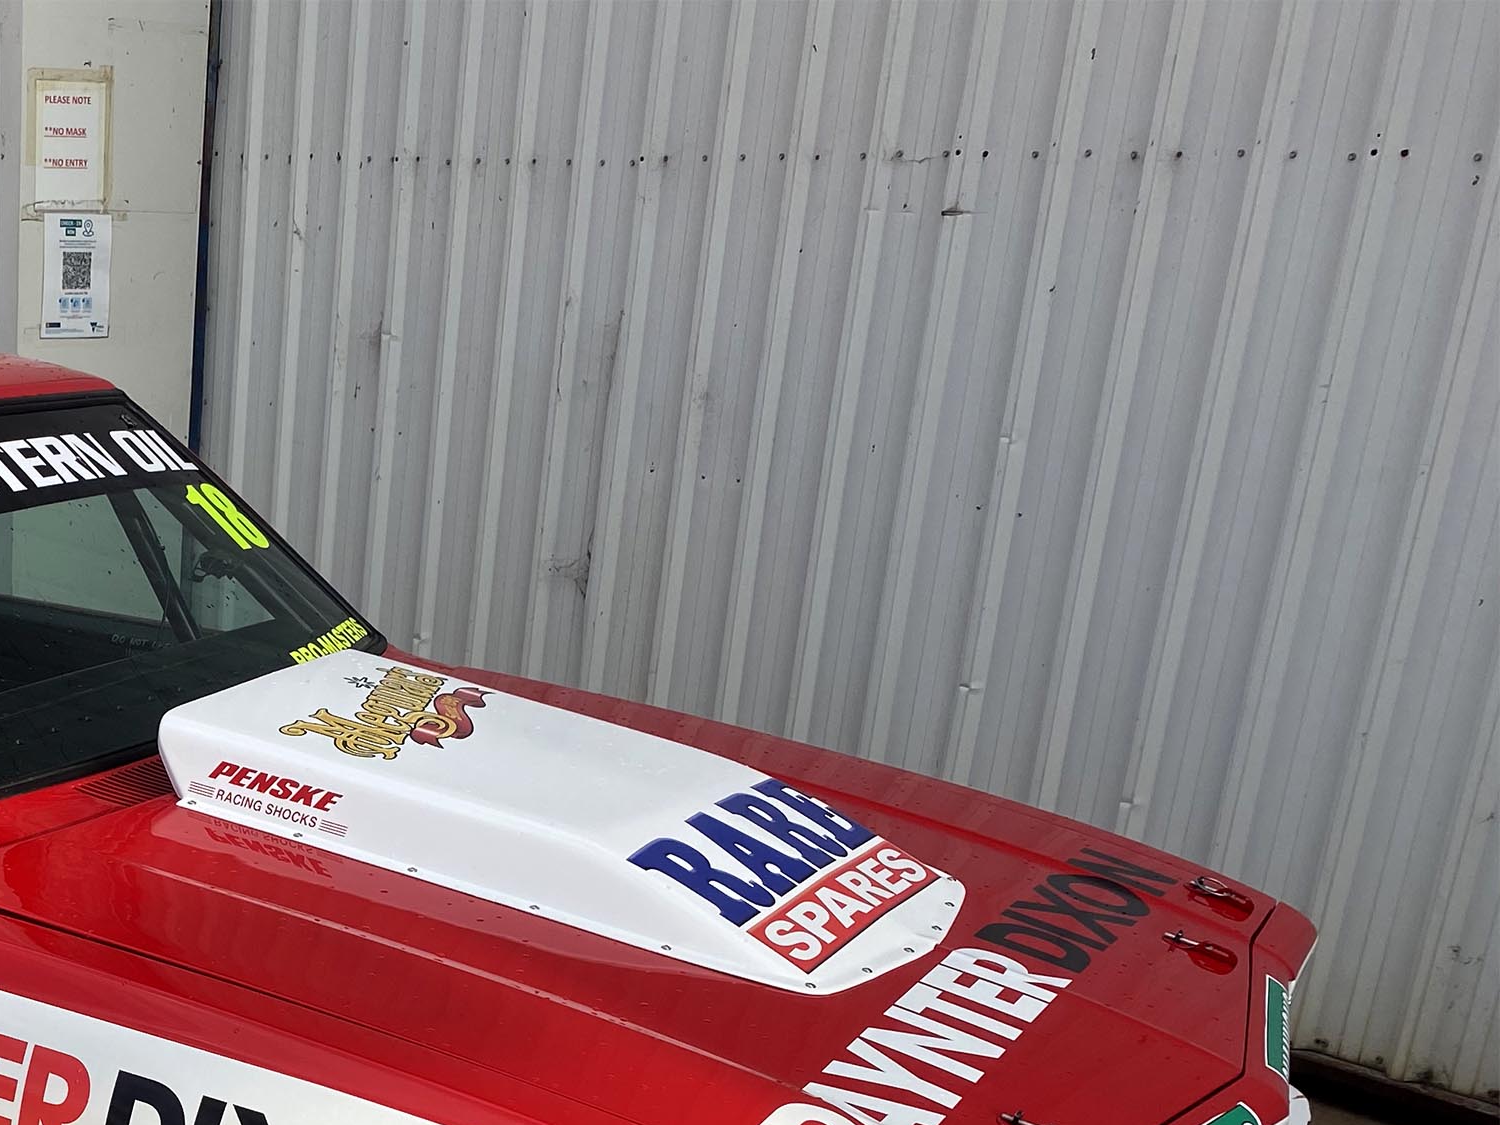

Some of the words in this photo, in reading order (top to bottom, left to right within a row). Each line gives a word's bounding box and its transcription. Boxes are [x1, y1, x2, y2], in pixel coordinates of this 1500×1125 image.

[44, 95, 70, 105] PLEASE
[72, 96, 92, 105] NOTE
[65, 127, 87, 137] MASK
[65, 159, 88, 169] ENTRY
[109, 429, 199, 475] OIL
[185, 483, 270, 550] 18
[208, 760, 344, 812] PENSKE
[215, 789, 263, 813] RACING
[265, 801, 318, 829] SHOCKS
[626, 777, 879, 928] RARE
[763, 848, 928, 963] SPARES
[971, 847, 1178, 975] DIXON
